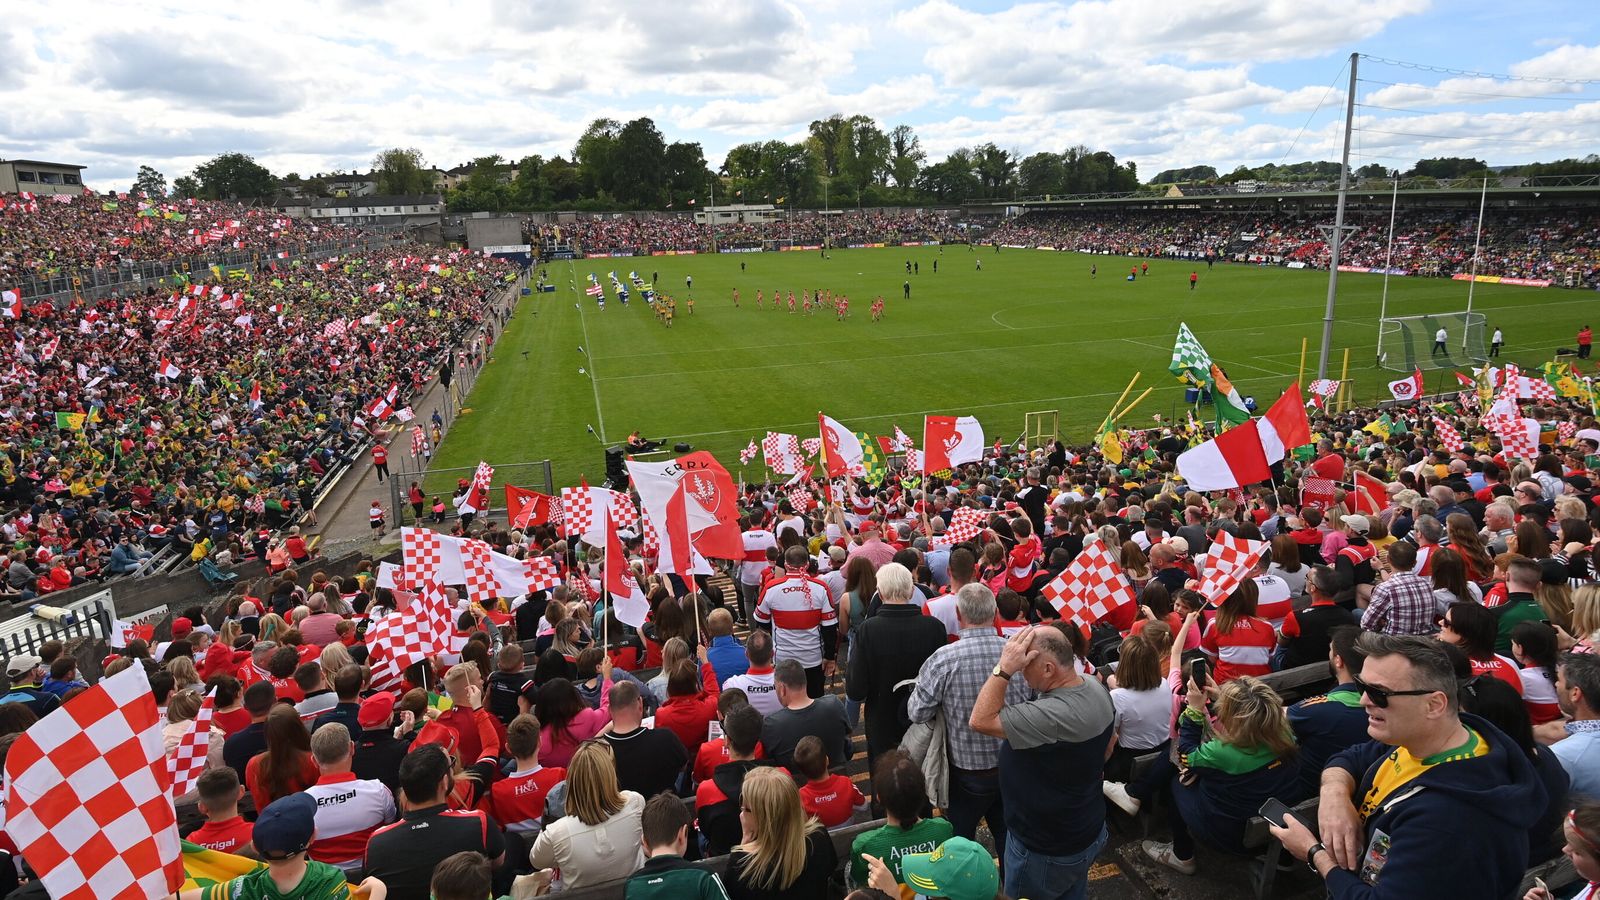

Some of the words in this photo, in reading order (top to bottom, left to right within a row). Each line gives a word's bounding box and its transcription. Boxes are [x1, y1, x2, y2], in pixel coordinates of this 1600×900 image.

[747, 684, 776, 694] Errigal
[317, 789, 357, 806] Errigal
[815, 791, 837, 803] Errigal
[200, 837, 235, 850] Errigal
